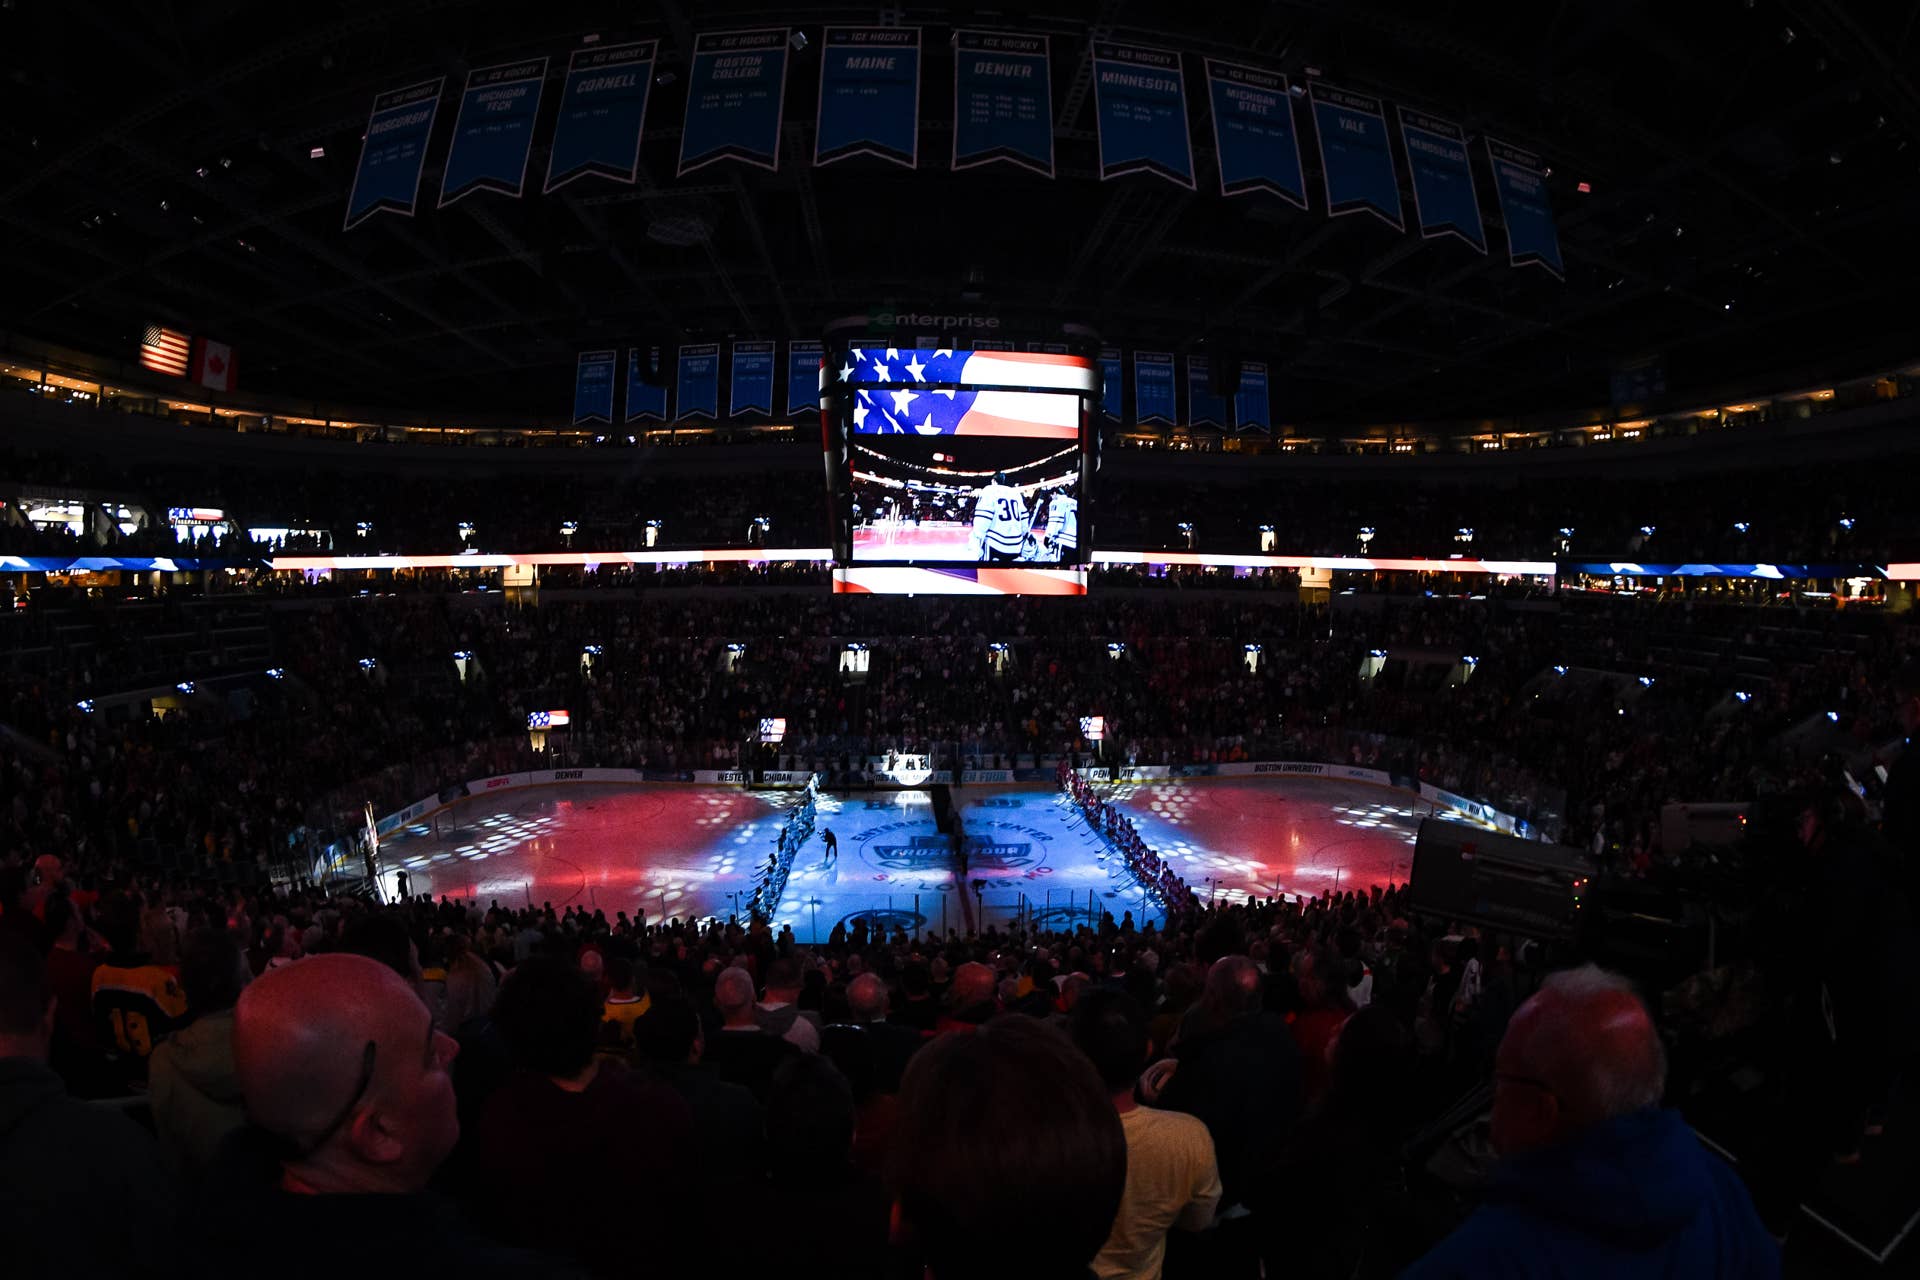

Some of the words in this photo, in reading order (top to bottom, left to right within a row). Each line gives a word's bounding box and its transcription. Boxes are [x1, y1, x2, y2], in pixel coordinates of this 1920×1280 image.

[845, 56, 897, 71] MAINE
[974, 61, 1033, 78] DENVER
[711, 67, 762, 80] COLLEGE
[576, 73, 637, 94] CORNELL
[1101, 71, 1178, 94] MINNESOTA
[1338, 116, 1368, 134] YALE
[876, 312, 1001, 330] enterprise
[997, 498, 1020, 521] 30
[555, 770, 583, 780] DENVER
[717, 772, 746, 782] WESTE
[763, 773, 792, 782] CHIGAN
[1254, 763, 1282, 773] BOSTON
[1282, 764, 1324, 774] UNIVERSITY
[987, 820, 1055, 842] CENTER
